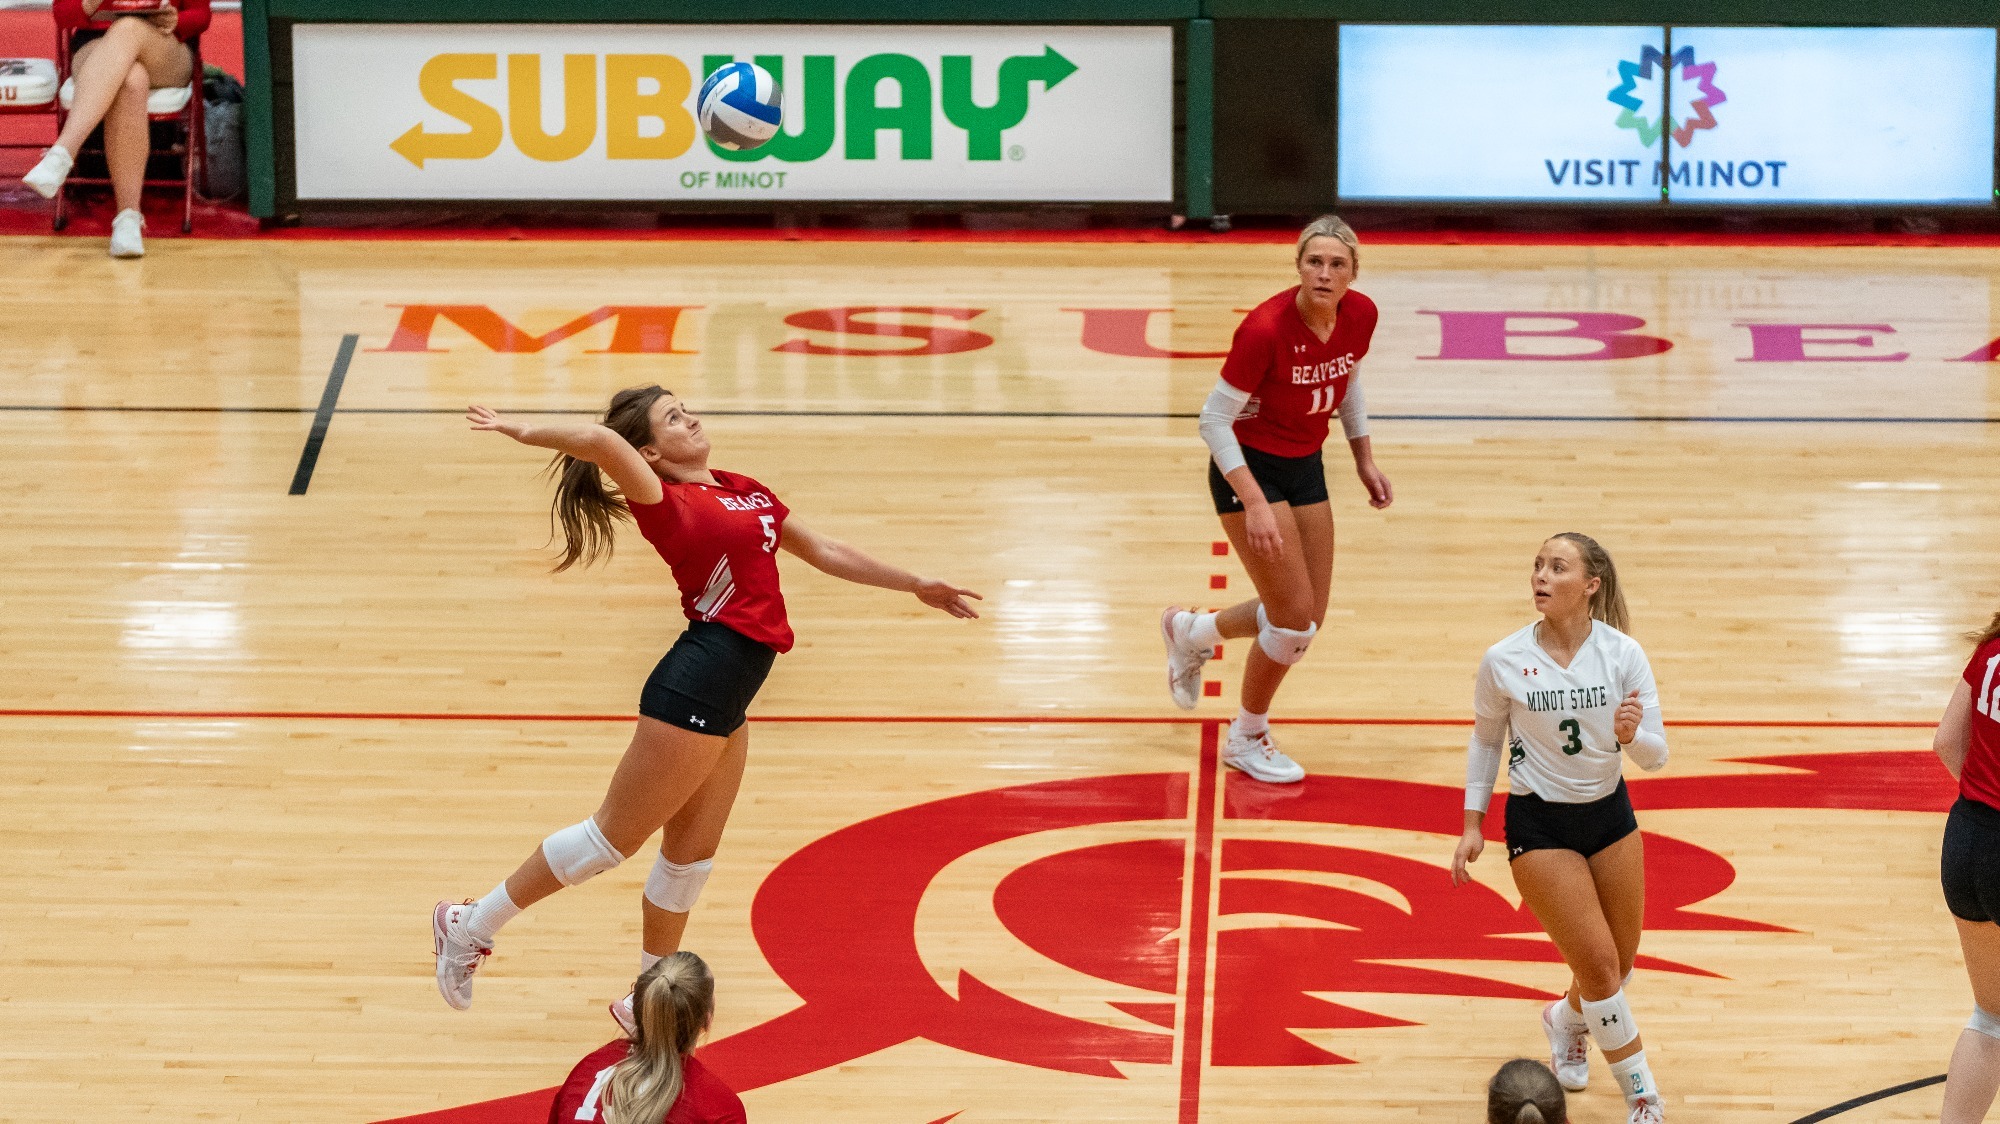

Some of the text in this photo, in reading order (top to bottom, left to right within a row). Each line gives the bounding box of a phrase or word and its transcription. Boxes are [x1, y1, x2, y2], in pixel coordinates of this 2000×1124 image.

[389, 44, 1079, 171] SUBWAY
[680, 171, 787, 189] OF MINOT
[1544, 159, 1787, 188] VISIT MINOT
[362, 303, 1255, 359] MSU
[1306, 384, 1335, 415] 11
[758, 514, 777, 553] 5
[1526, 686, 1607, 712] MINOT STATE
[1558, 718, 1583, 756] 3
